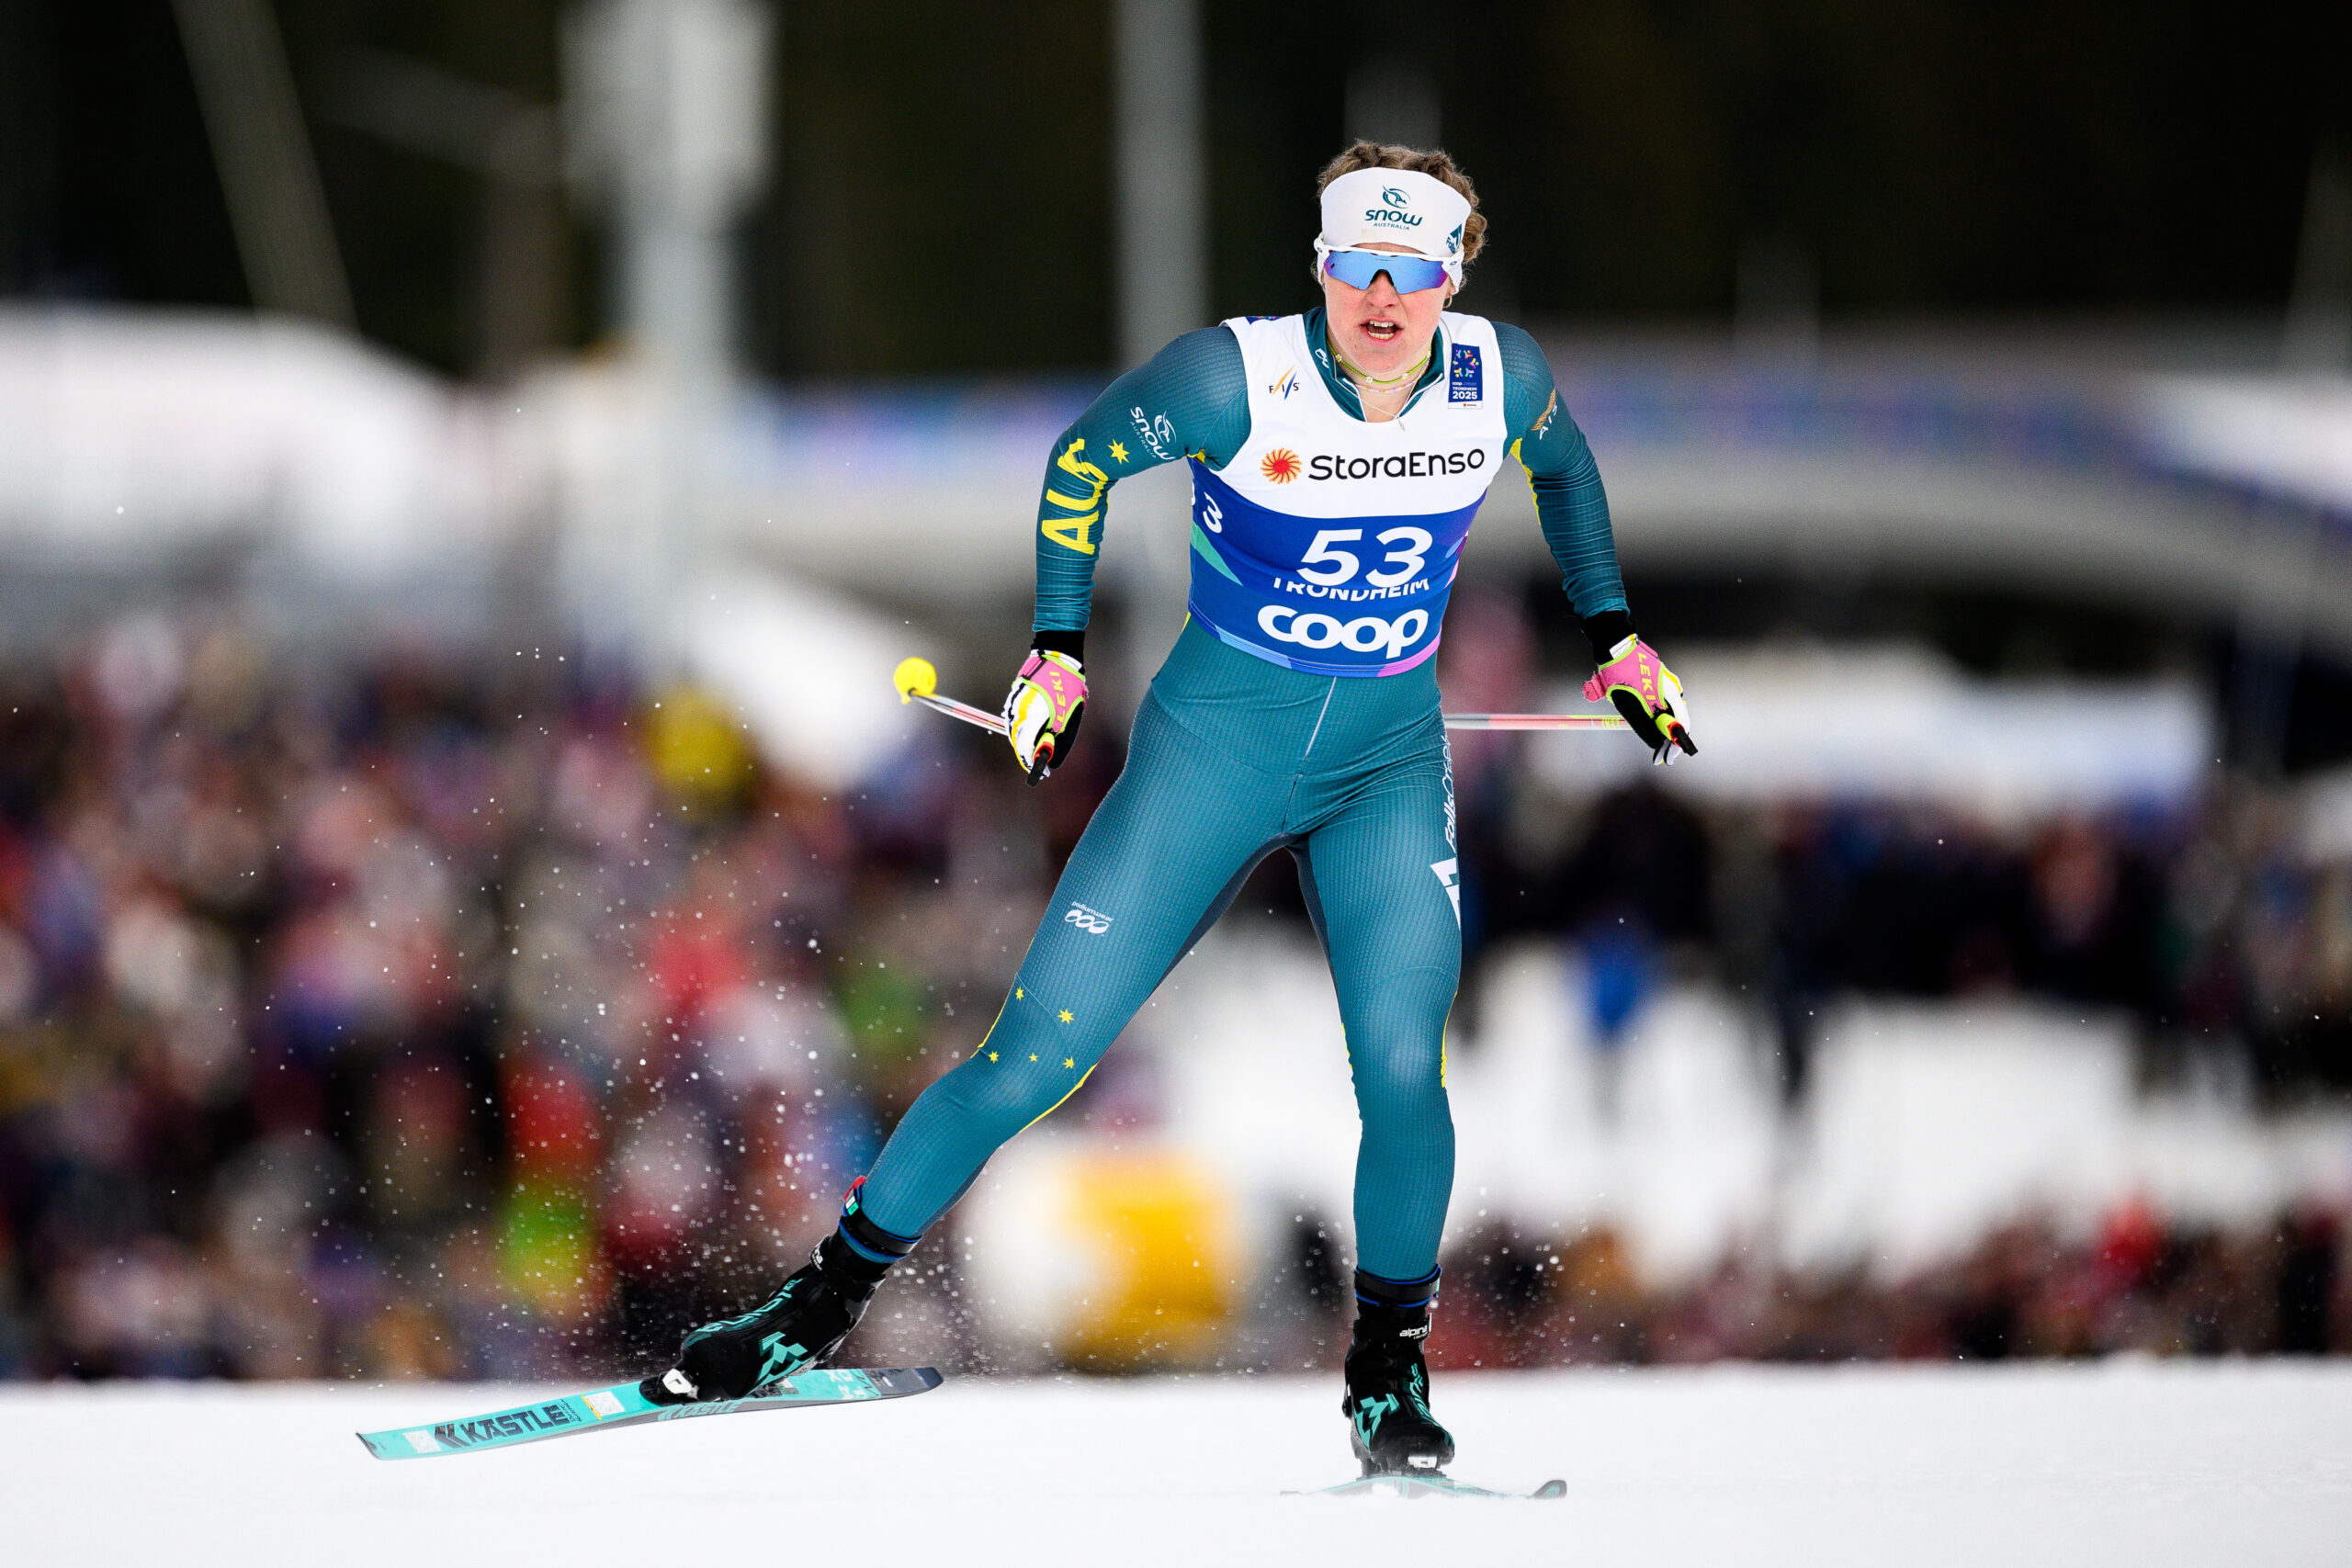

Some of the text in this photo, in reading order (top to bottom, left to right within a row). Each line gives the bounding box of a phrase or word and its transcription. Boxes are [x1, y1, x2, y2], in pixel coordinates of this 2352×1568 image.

[1364, 209, 1423, 226] snow
[1374, 222, 1410, 231] AUSTRALIA
[1453, 391, 1477, 400] 2025
[1130, 406, 1176, 460] snow
[1296, 526, 1433, 588] 53
[1257, 604, 1430, 660] coop
[1049, 671, 1066, 724] LEKI
[1637, 652, 1657, 701] LEKI
